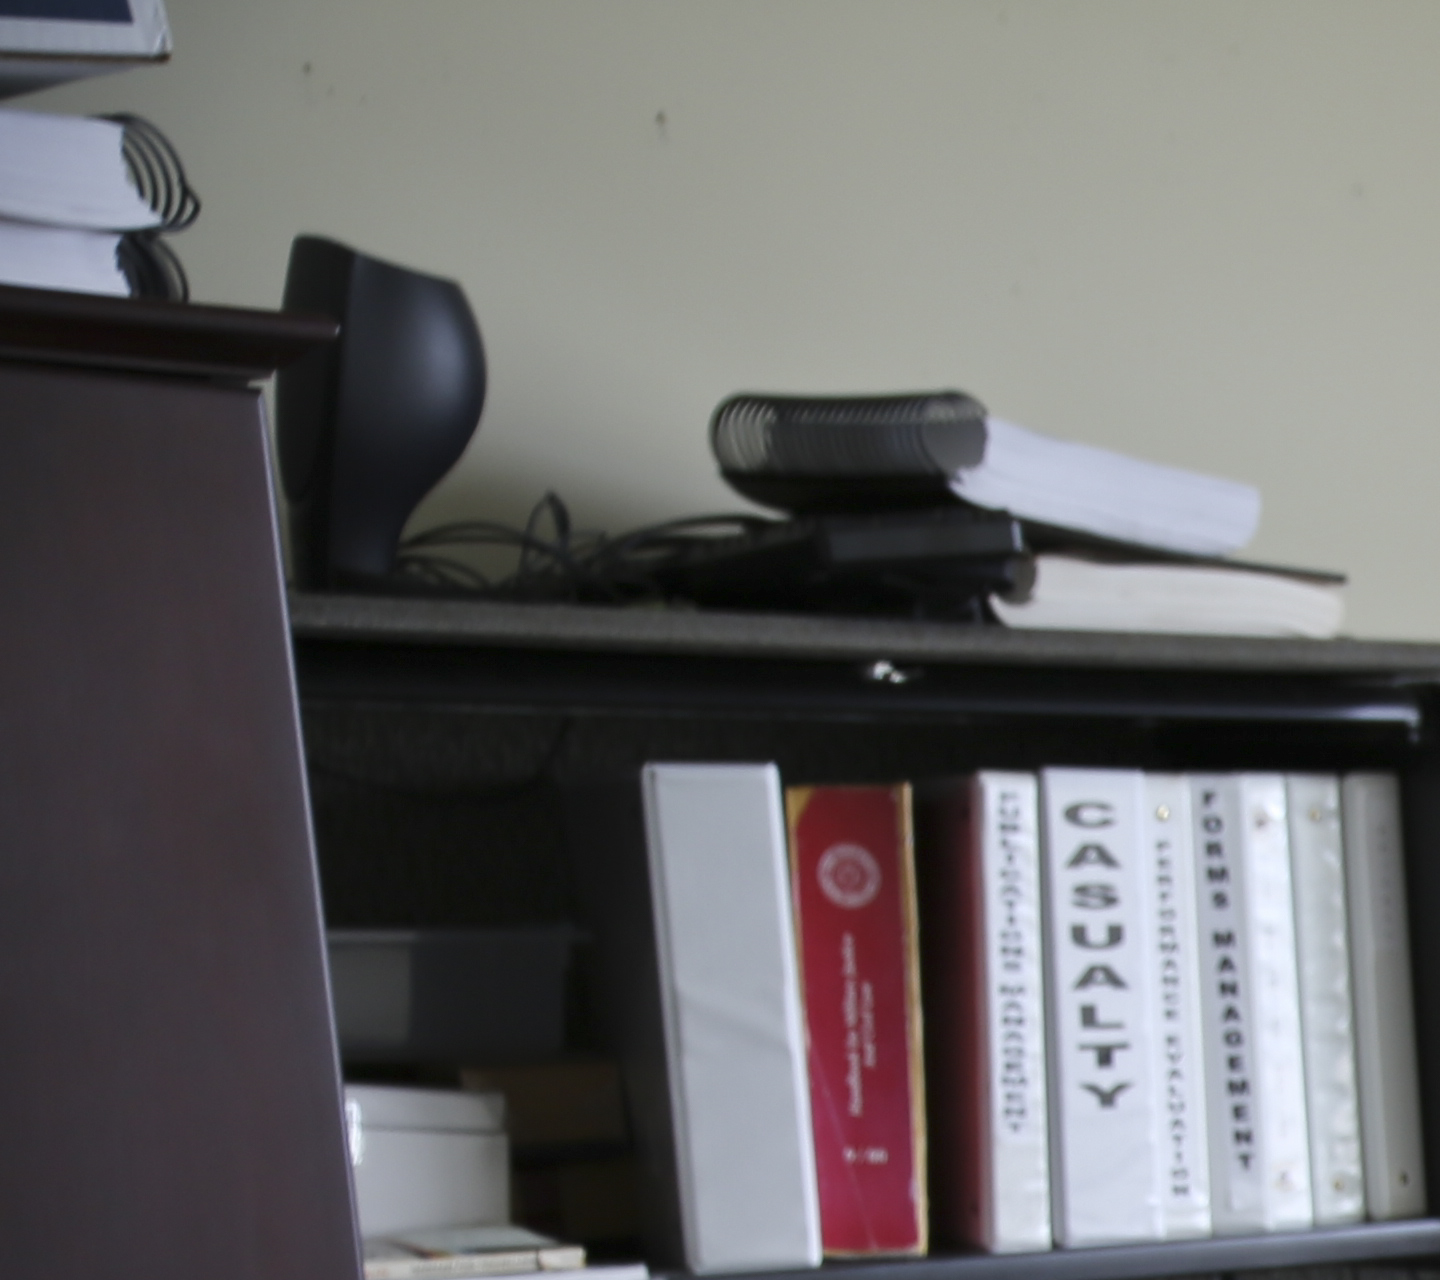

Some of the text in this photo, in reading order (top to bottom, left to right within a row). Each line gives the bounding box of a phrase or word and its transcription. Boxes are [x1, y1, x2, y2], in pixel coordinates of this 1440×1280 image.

[1062, 802, 1133, 1108] CASUALTY
[1203, 790, 1254, 1170] FORMS MANAGEMENT
